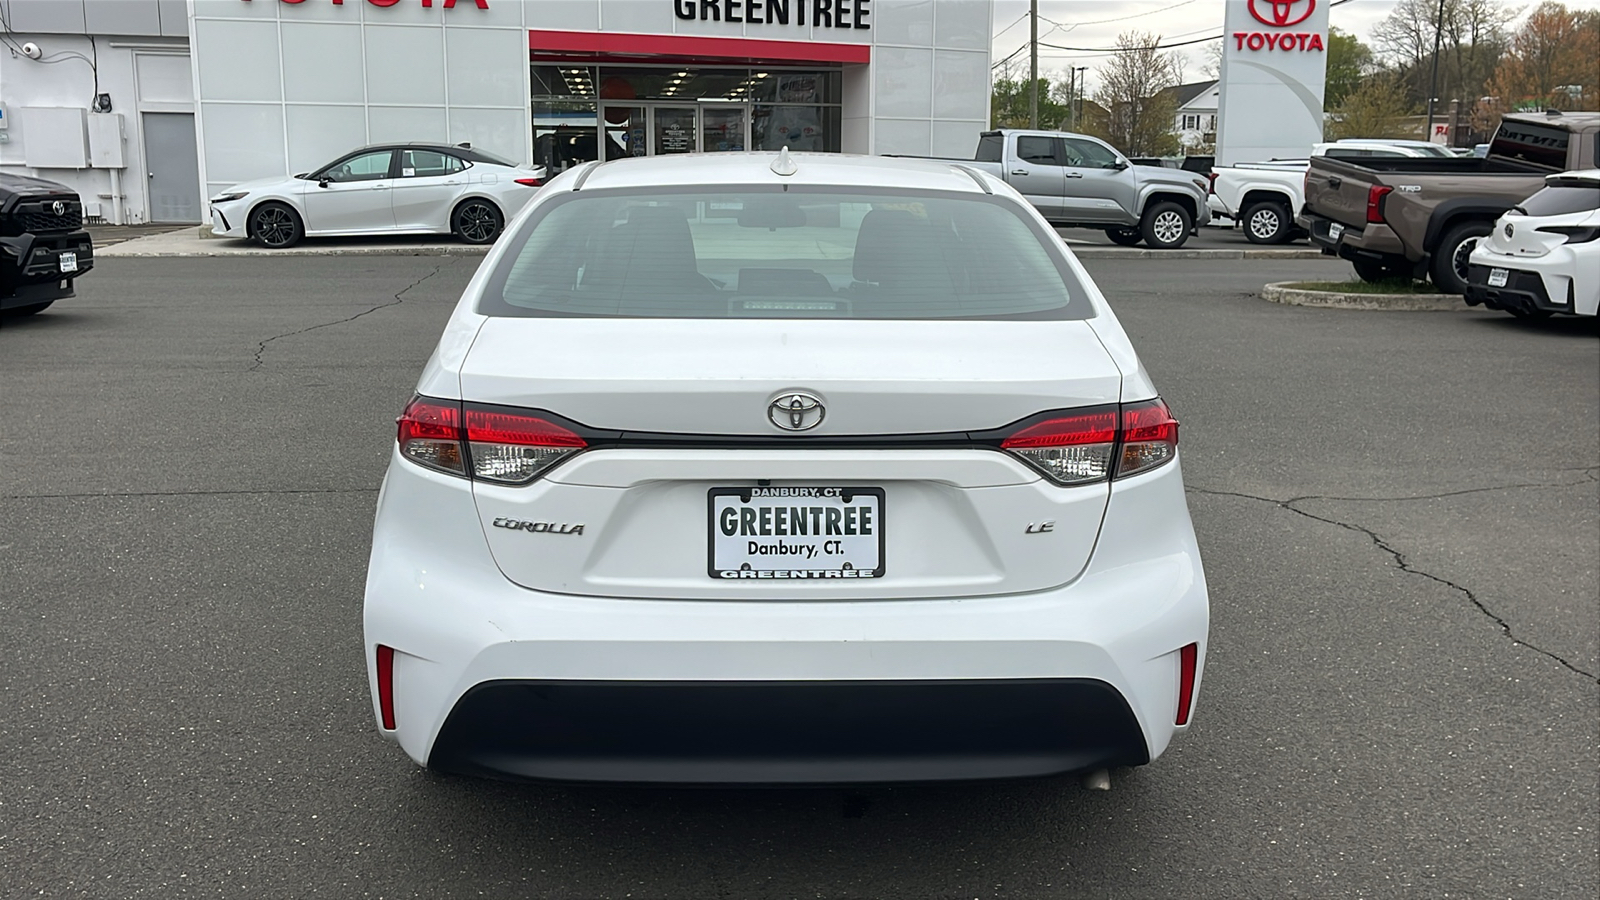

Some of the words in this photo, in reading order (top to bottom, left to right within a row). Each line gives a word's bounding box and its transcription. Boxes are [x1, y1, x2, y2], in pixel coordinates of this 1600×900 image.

[674, 0, 871, 30] GREENTREE
[1233, 32, 1324, 52] TOYOTA
[1399, 185, 1421, 193] TRD
[751, 488, 820, 498] DANBURY,
[823, 488, 843, 497] CT
[492, 516, 585, 536] COROLLA
[720, 506, 873, 537] GREENTREE
[1025, 520, 1056, 534] LE
[748, 540, 819, 559] Danbury,
[823, 540, 845, 555] CT.
[719, 569, 875, 579] GREENTREE
